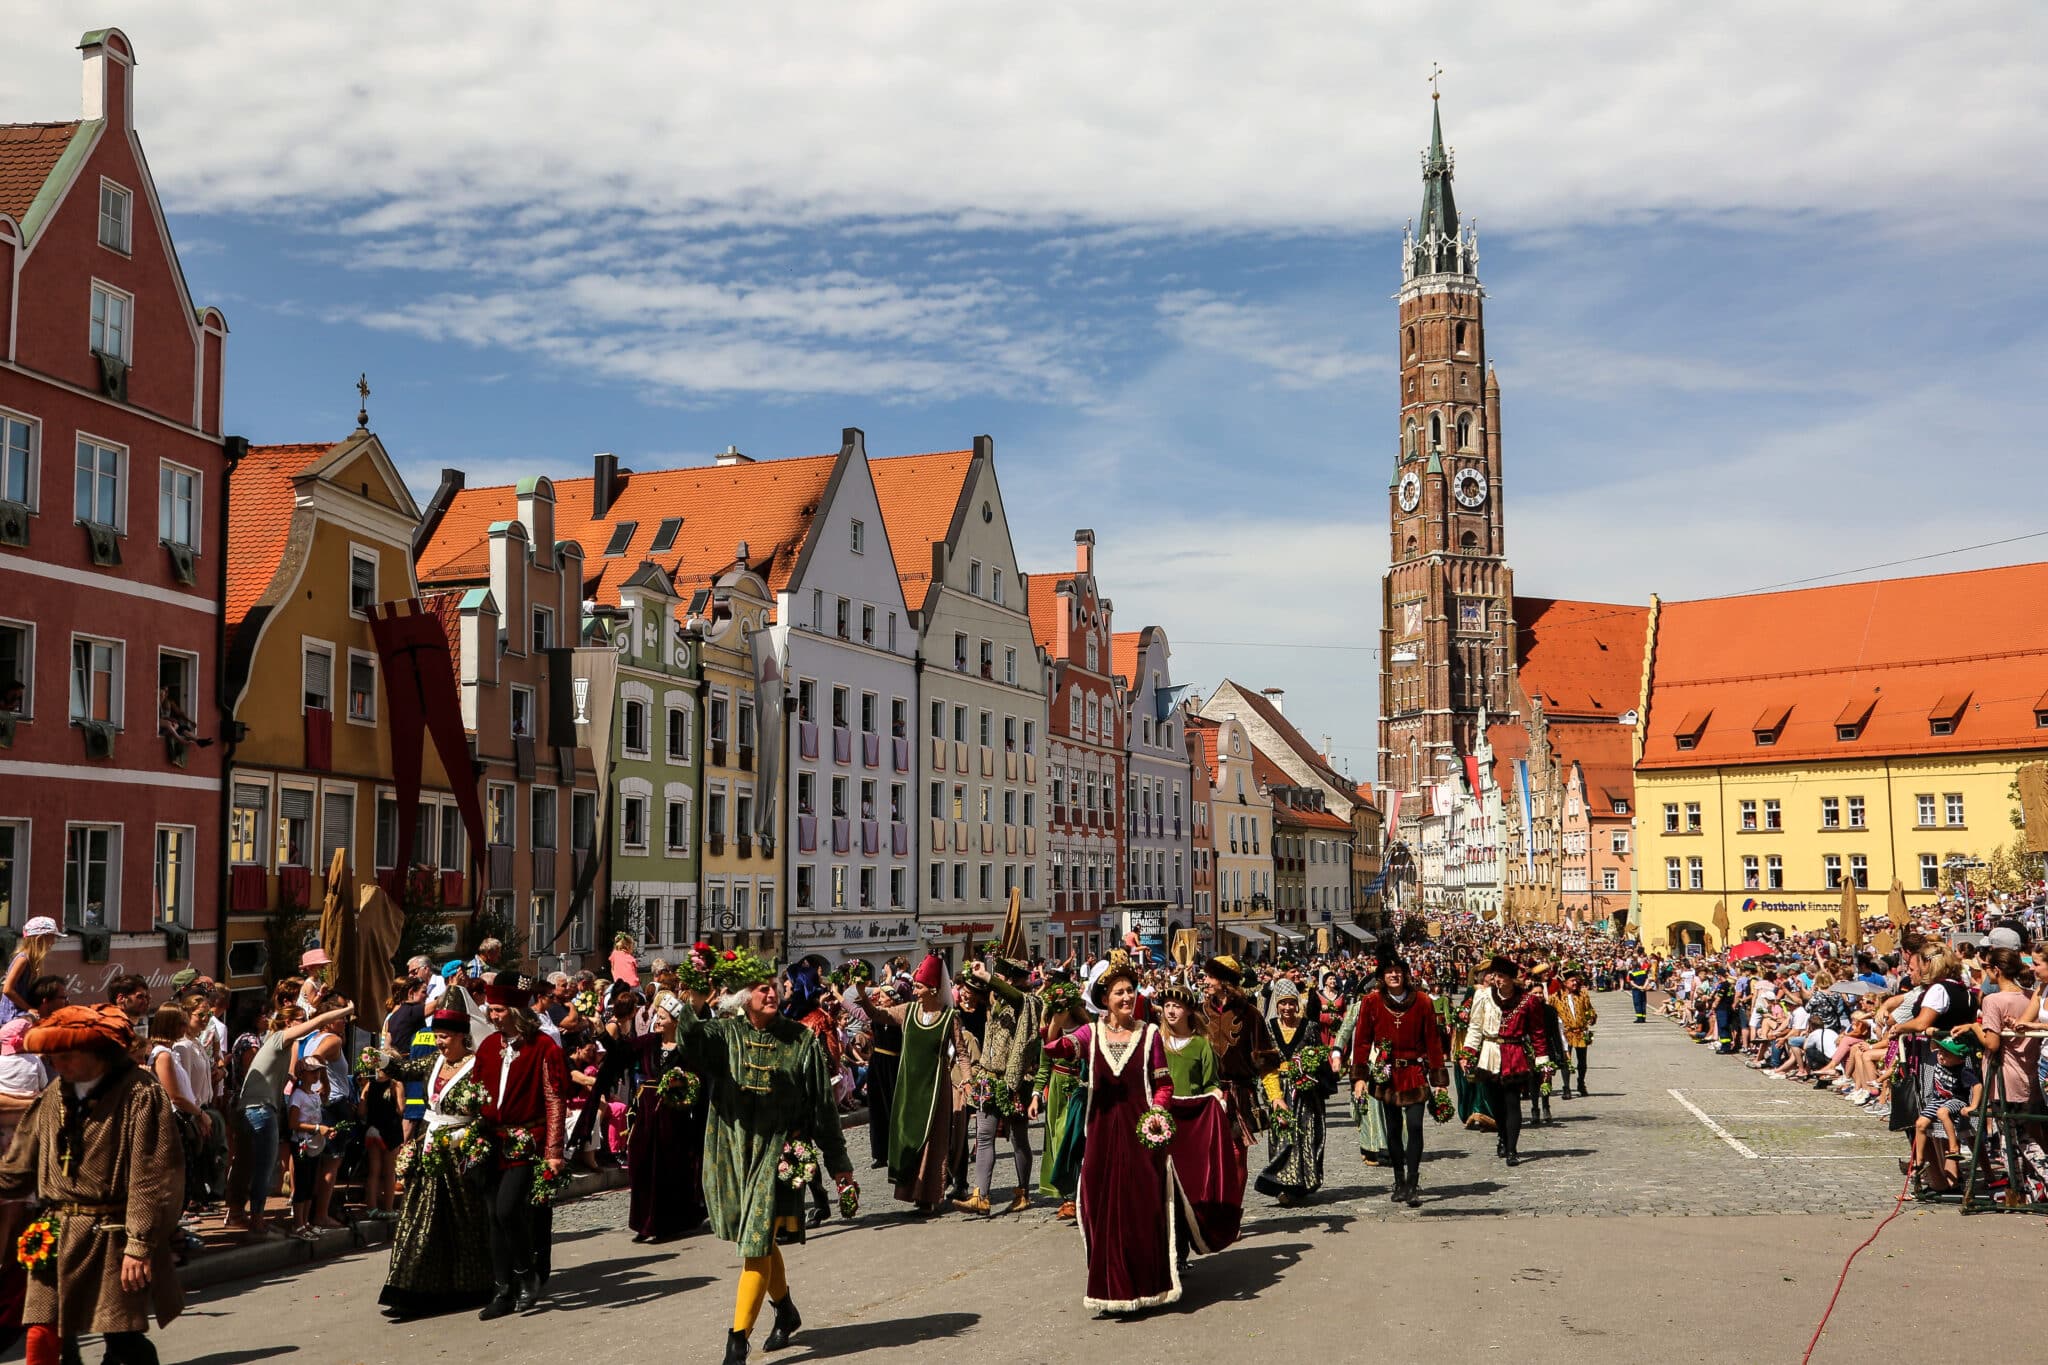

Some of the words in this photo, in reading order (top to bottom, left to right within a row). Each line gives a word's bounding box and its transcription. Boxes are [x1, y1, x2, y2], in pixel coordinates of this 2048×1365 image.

[1761, 901, 1807, 912] Postbank
[1807, 901, 1870, 913] Finanzer
[1131, 910, 1143, 918] AUF
[1144, 910, 1160, 918] DICKE
[1131, 918, 1161, 927] GEMACHT.
[1140, 926, 1160, 935] SKINNY
